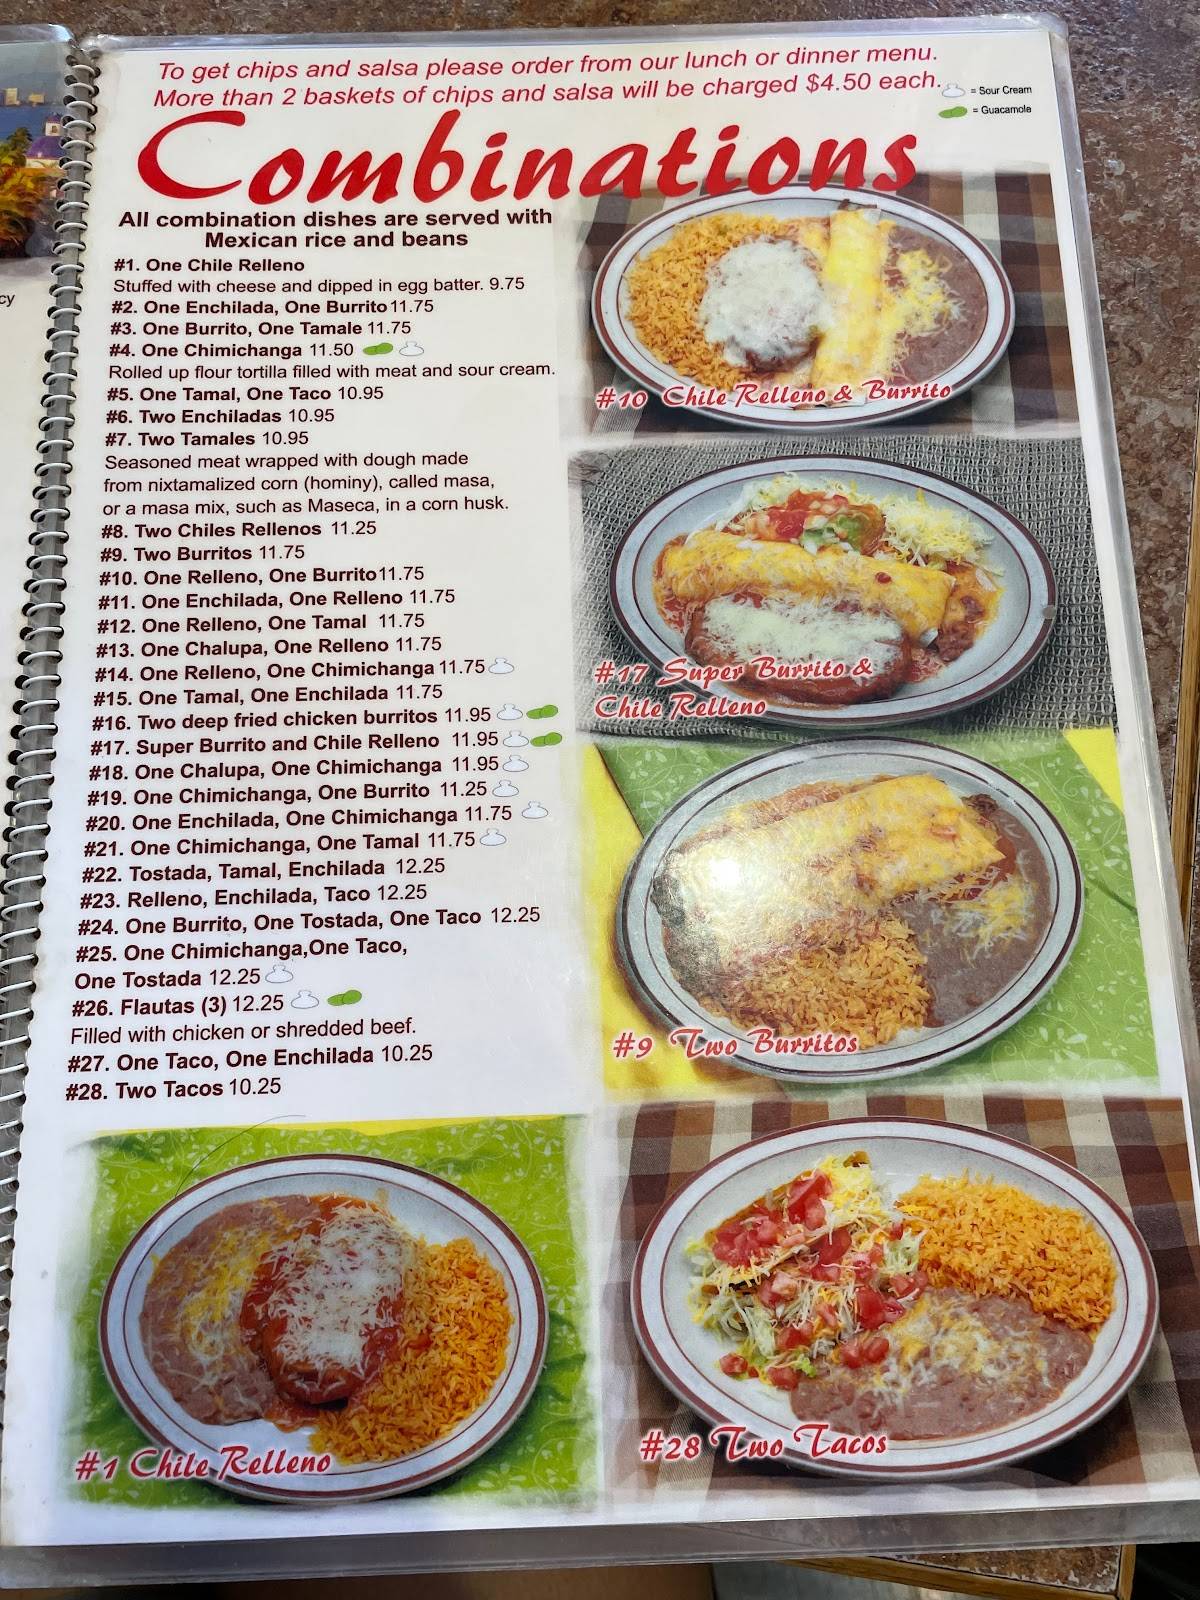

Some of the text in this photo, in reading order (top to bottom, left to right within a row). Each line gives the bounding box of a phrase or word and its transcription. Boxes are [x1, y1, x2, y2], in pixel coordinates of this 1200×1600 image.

[159, 47, 937, 84] To get chips and salsa please order from our lunch or dinner menu.
[153, 70, 941, 108] More than 2 baskets of chips and salsa will be charged $4.50 each.
[979, 86, 1000, 95] Sour
[1002, 85, 1032, 95] Cream
[981, 104, 1032, 115] Guacamole
[137, 109, 918, 205] Combinations
[118, 208, 552, 228] All combination dishes are served with
[205, 230, 468, 248] Mexican rice and beans
[114, 258, 305, 272] #1. One Chile Relleno
[113, 277, 525, 295] Stuffed with cheese and dipped in egg batter. 9.75
[111, 299, 434, 316] #2. One Enchilada, One Burrito 11.75
[109, 343, 354, 360] #4. One Chimichanga 11.50
[109, 363, 555, 382] Rolled up flour tortilla filled with meat and sour cream.
[596, 380, 952, 408] #10 Chile Relleno & Burrito
[105, 431, 309, 447] #7. Two Tamales 10.95
[103, 474, 494, 494] from nixtamalized corn (hominy), called masa,
[101, 520, 377, 539] #8. Two Chiles Rellenos 11.25
[98, 589, 455, 610] #11. One Enchilada, One Relleno 11.75
[95, 659, 485, 683] #14. One Relleno, One Chimichanga 11.75
[595, 656, 873, 688] #17 Super Burrito &
[595, 693, 767, 719] Chile Relleno
[92, 707, 491, 732] #16. Two deep fried chicken burritos 11.95
[85, 805, 512, 832] #20. One Enchilada, One Chimichanga 11.75
[78, 906, 540, 936] #24. One Burrito, One Tostada, One Taco 12.25
[74, 968, 261, 990] One Tostada 12.25
[613, 1028, 857, 1059] #9 Two Burritos
[65, 1077, 281, 1101] #28. Two Tacos 10.25
[640, 1423, 887, 1460] #28 Two Tacos
[76, 1446, 331, 1481] #1 Chile Relleno
